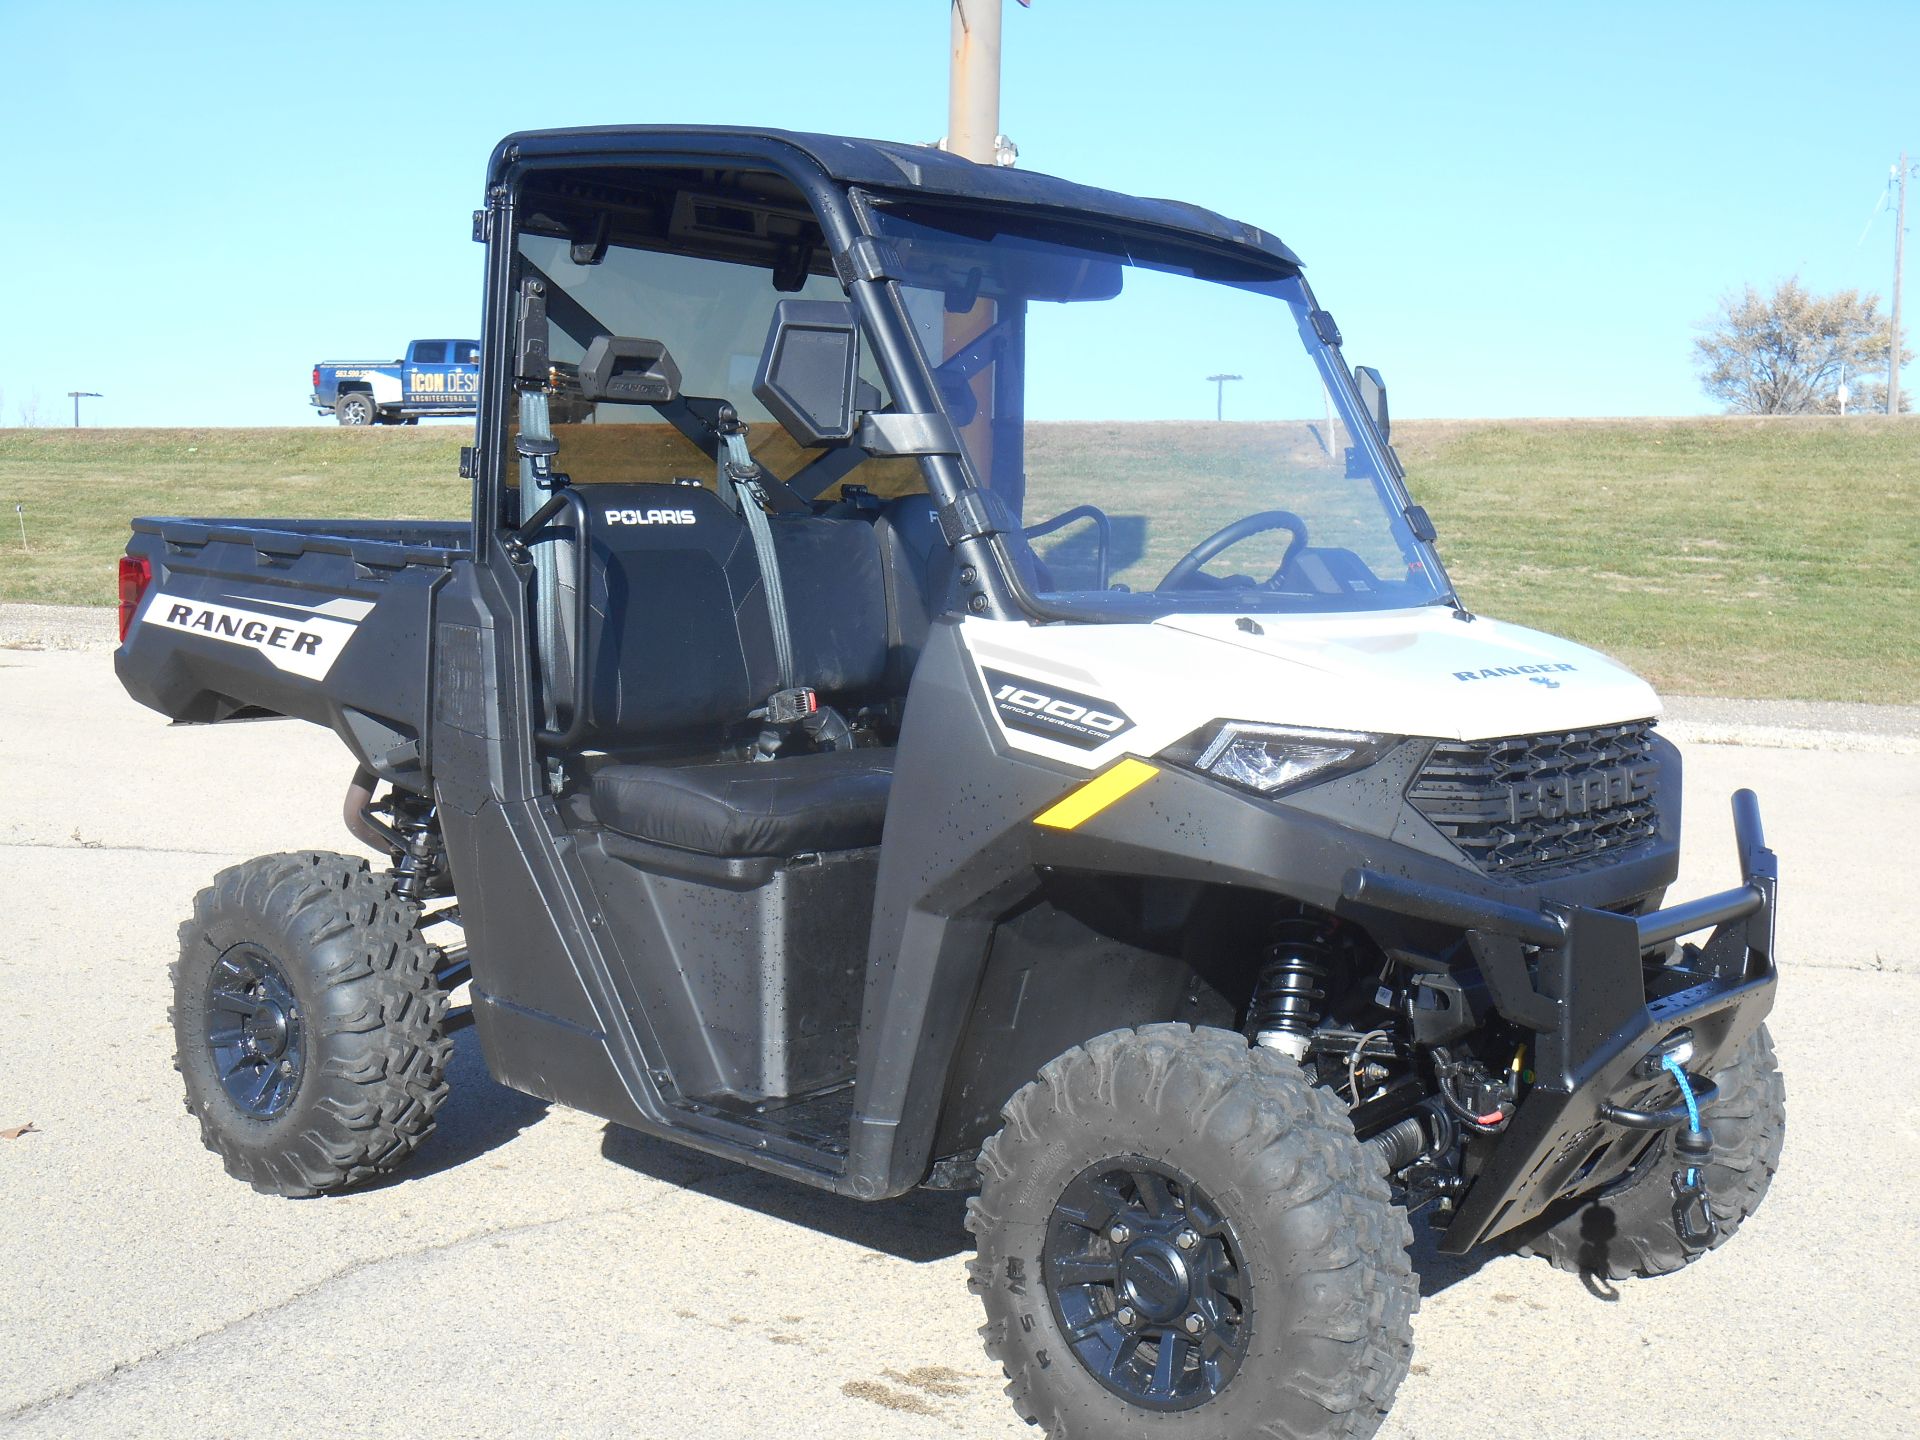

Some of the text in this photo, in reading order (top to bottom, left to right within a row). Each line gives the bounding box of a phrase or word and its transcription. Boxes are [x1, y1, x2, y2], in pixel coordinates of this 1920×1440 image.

[411, 373, 444, 392] ICON
[605, 509, 697, 526] POLARIS
[166, 603, 324, 656] RANGER
[1452, 663, 1579, 682] RANGER
[994, 684, 1126, 733] 1000
